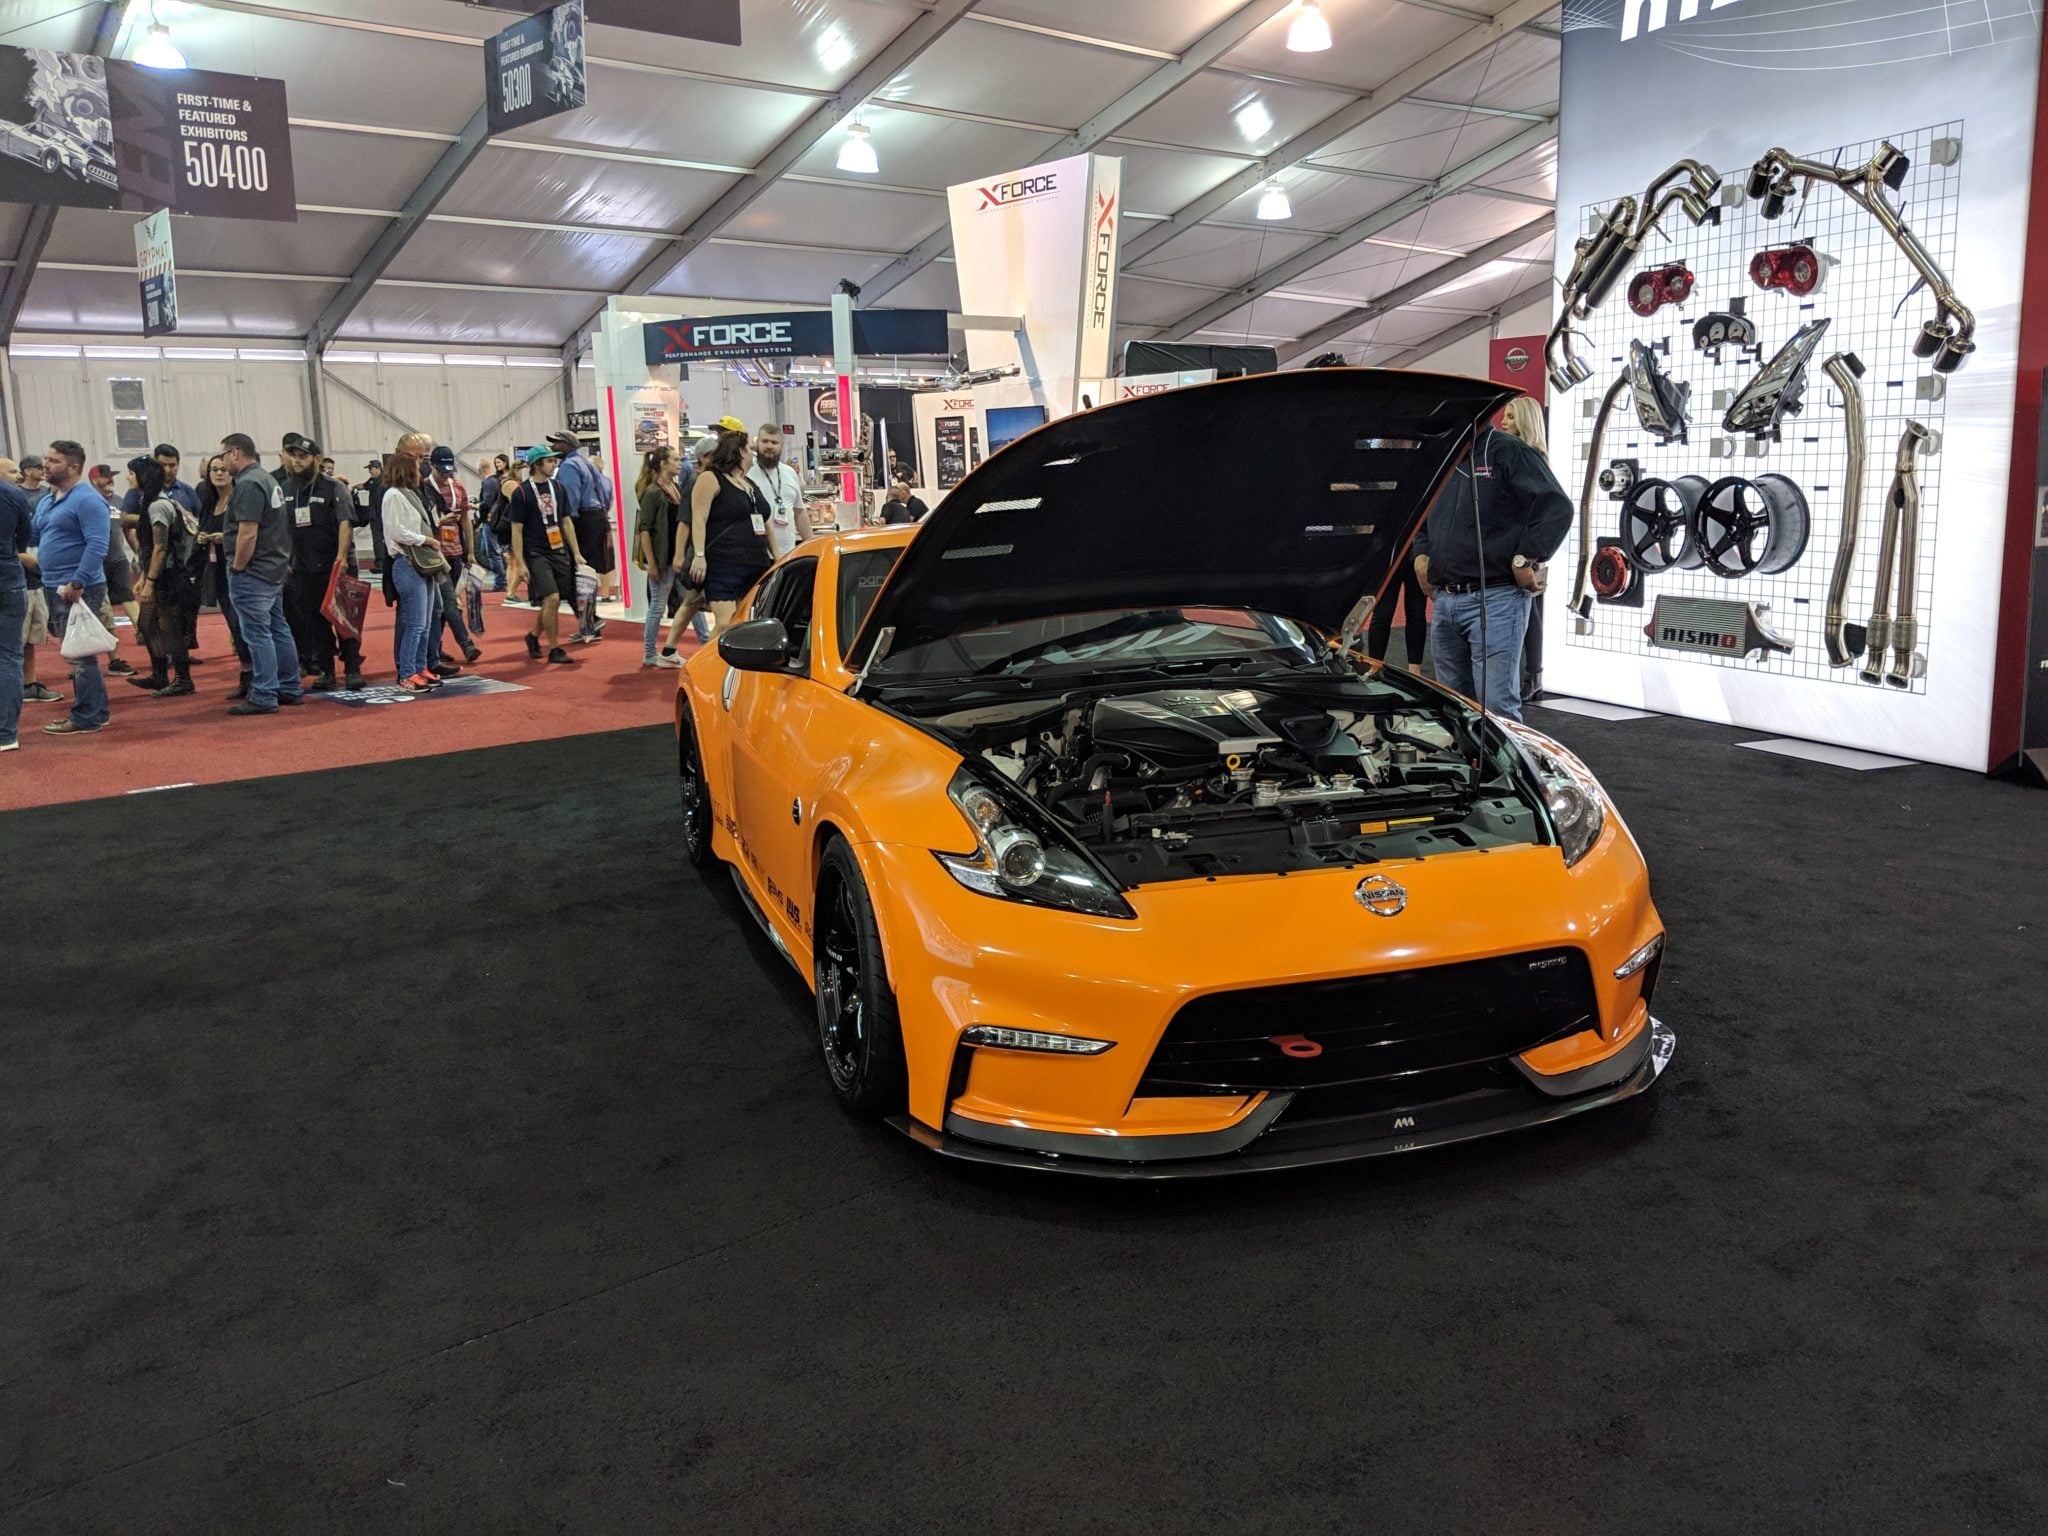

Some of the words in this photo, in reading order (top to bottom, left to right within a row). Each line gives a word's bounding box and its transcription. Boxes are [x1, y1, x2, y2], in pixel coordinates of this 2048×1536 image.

[502, 63, 532, 114] 50300
[177, 93, 240, 110] FIRST-TIME
[242, 100, 252, 112] &
[178, 109, 236, 125] FEATURED
[180, 125, 248, 141] EXHIBITORS
[184, 141, 268, 192] 50400
[977, 174, 1057, 211] XFORCE
[1093, 184, 1116, 330] XFORCE
[659, 321, 792, 353] XFORCE
[665, 351, 712, 359] PERFORMANCE
[714, 348, 750, 356] EXHAUST
[753, 346, 792, 354] SYSTEMS
[942, 399, 975, 410] XFORC
[1361, 889, 1404, 900] NISSAN
